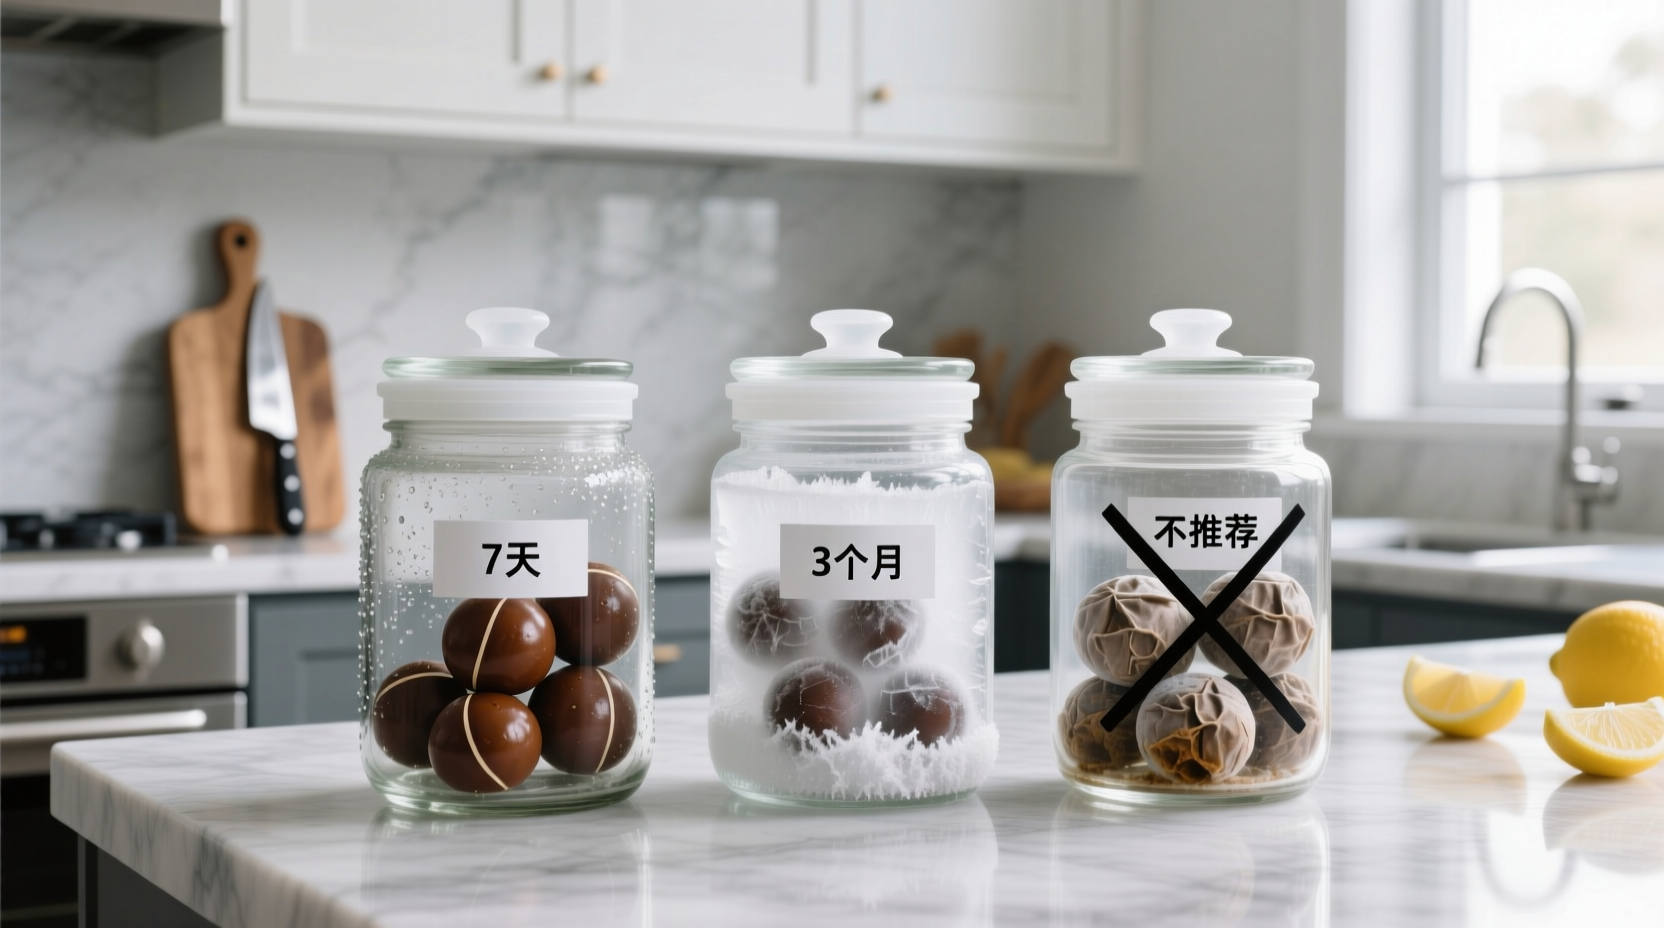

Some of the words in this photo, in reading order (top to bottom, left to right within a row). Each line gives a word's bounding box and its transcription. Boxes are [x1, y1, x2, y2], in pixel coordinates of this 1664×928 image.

[1154, 513, 1259, 549] 不推荐
[481, 541, 541, 578] 7天
[811, 543, 902, 581] 3个月
